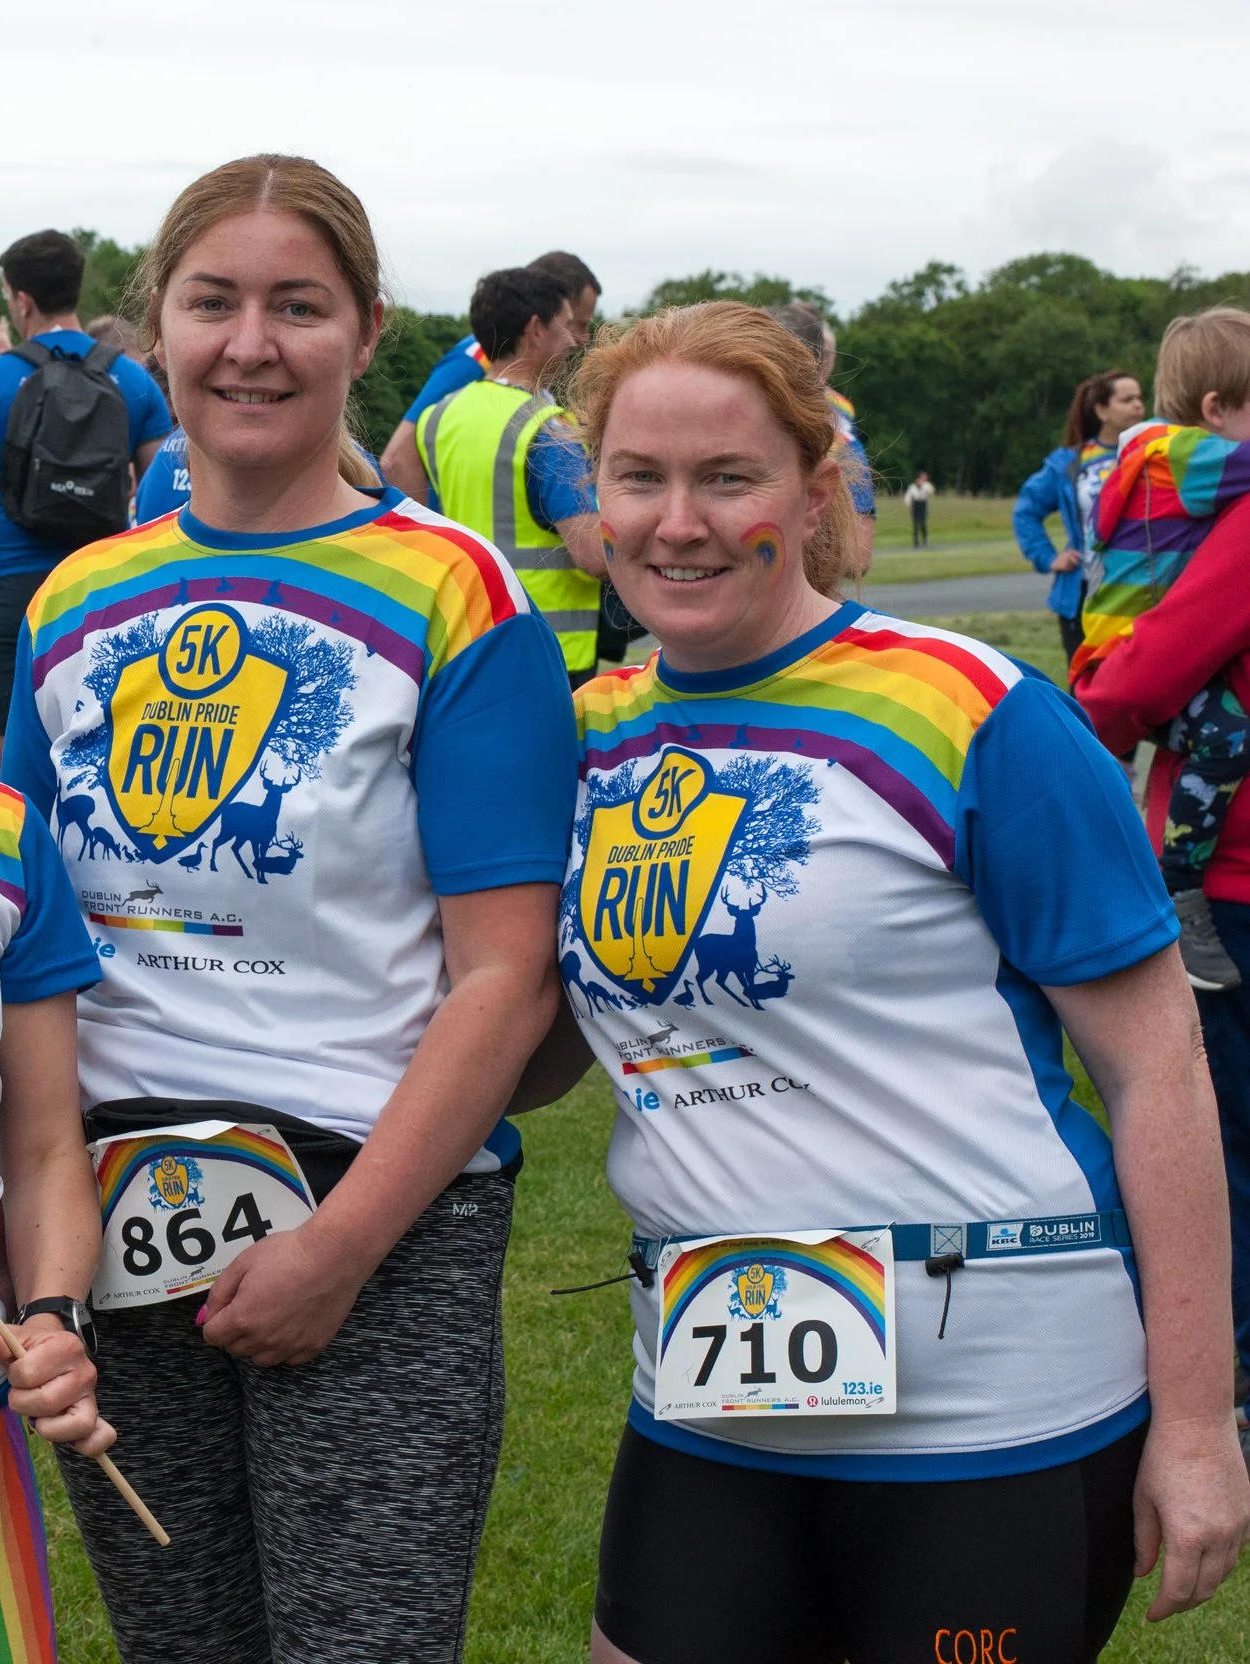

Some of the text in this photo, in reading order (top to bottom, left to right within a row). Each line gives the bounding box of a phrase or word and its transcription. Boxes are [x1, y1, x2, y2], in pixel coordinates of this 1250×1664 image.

[176, 624, 230, 676] 5K
[141, 702, 240, 725] DUBLIN PRIDE
[121, 724, 235, 800] RUN
[648, 766, 696, 819] 5K
[607, 836, 695, 864] DUBLIN PRIDE
[81, 890, 121, 902] DUBLIN
[594, 859, 691, 942] RUN
[84, 901, 242, 922] FRONT RUNNERS A.C.
[136, 952, 226, 972] ARTHUR
[233, 960, 285, 975] COX
[674, 1082, 766, 1109] ARTHUR
[121, 1192, 274, 1277] 864
[1030, 1221, 1095, 1236] DUBLIN
[991, 1237, 1018, 1245] KBC
[750, 1267, 761, 1279] 5K
[113, 1287, 161, 1299] ARTHUR COX
[745, 1289, 765, 1306] RUN
[692, 1319, 838, 1387] 710
[842, 1382, 883, 1395] 123.ie
[674, 1402, 701, 1410] ARTHUR
[821, 1396, 866, 1406] lululemon
[935, 1628, 1017, 1664] CORC
